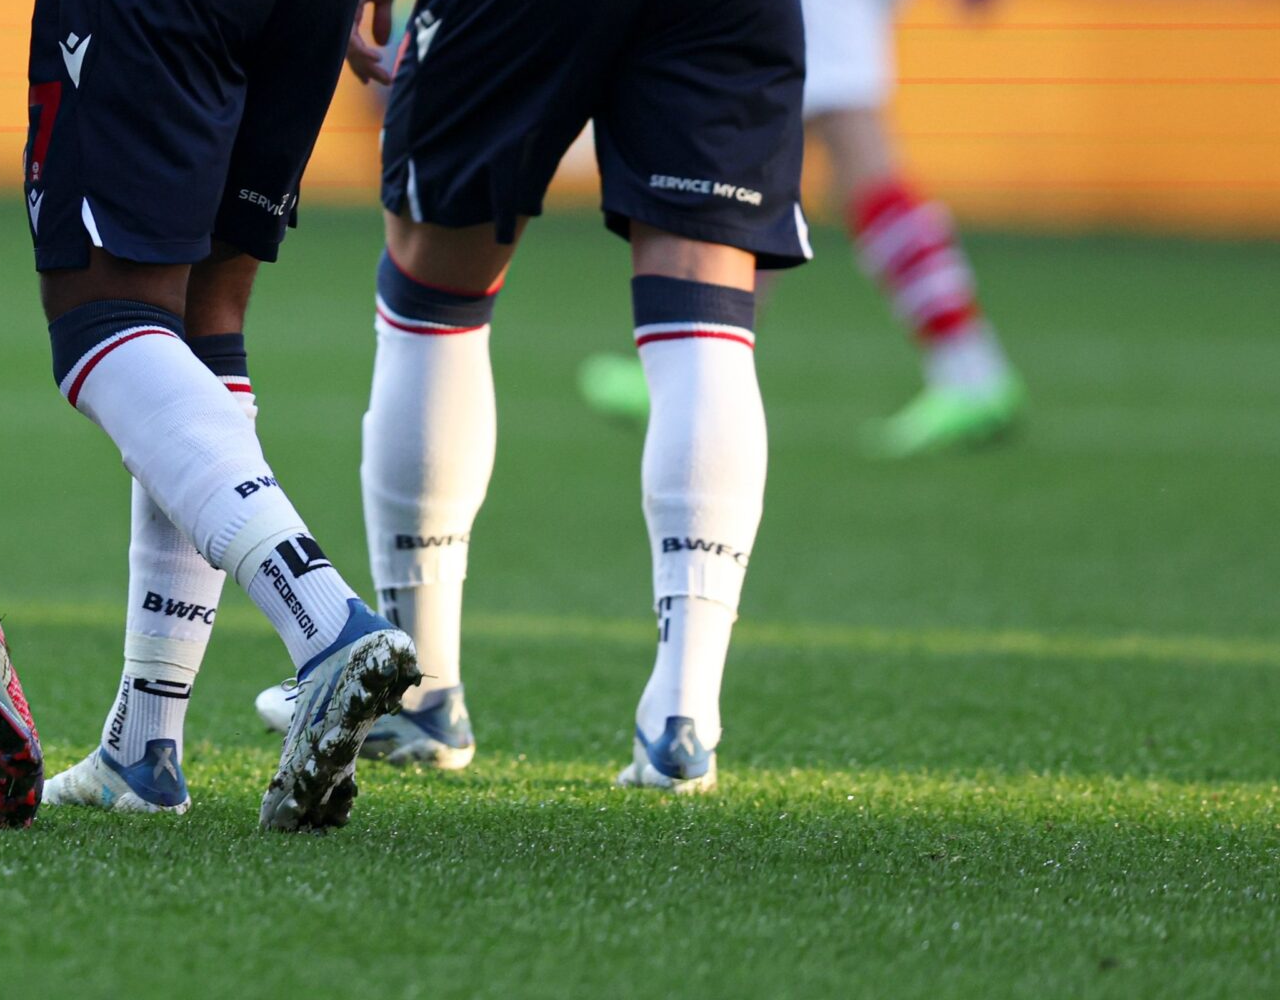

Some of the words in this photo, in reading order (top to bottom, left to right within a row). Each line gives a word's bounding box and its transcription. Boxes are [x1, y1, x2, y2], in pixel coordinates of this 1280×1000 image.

[649, 174, 712, 194] SERVICE
[712, 182, 736, 198] MY
[142, 591, 217, 625] BWFC
